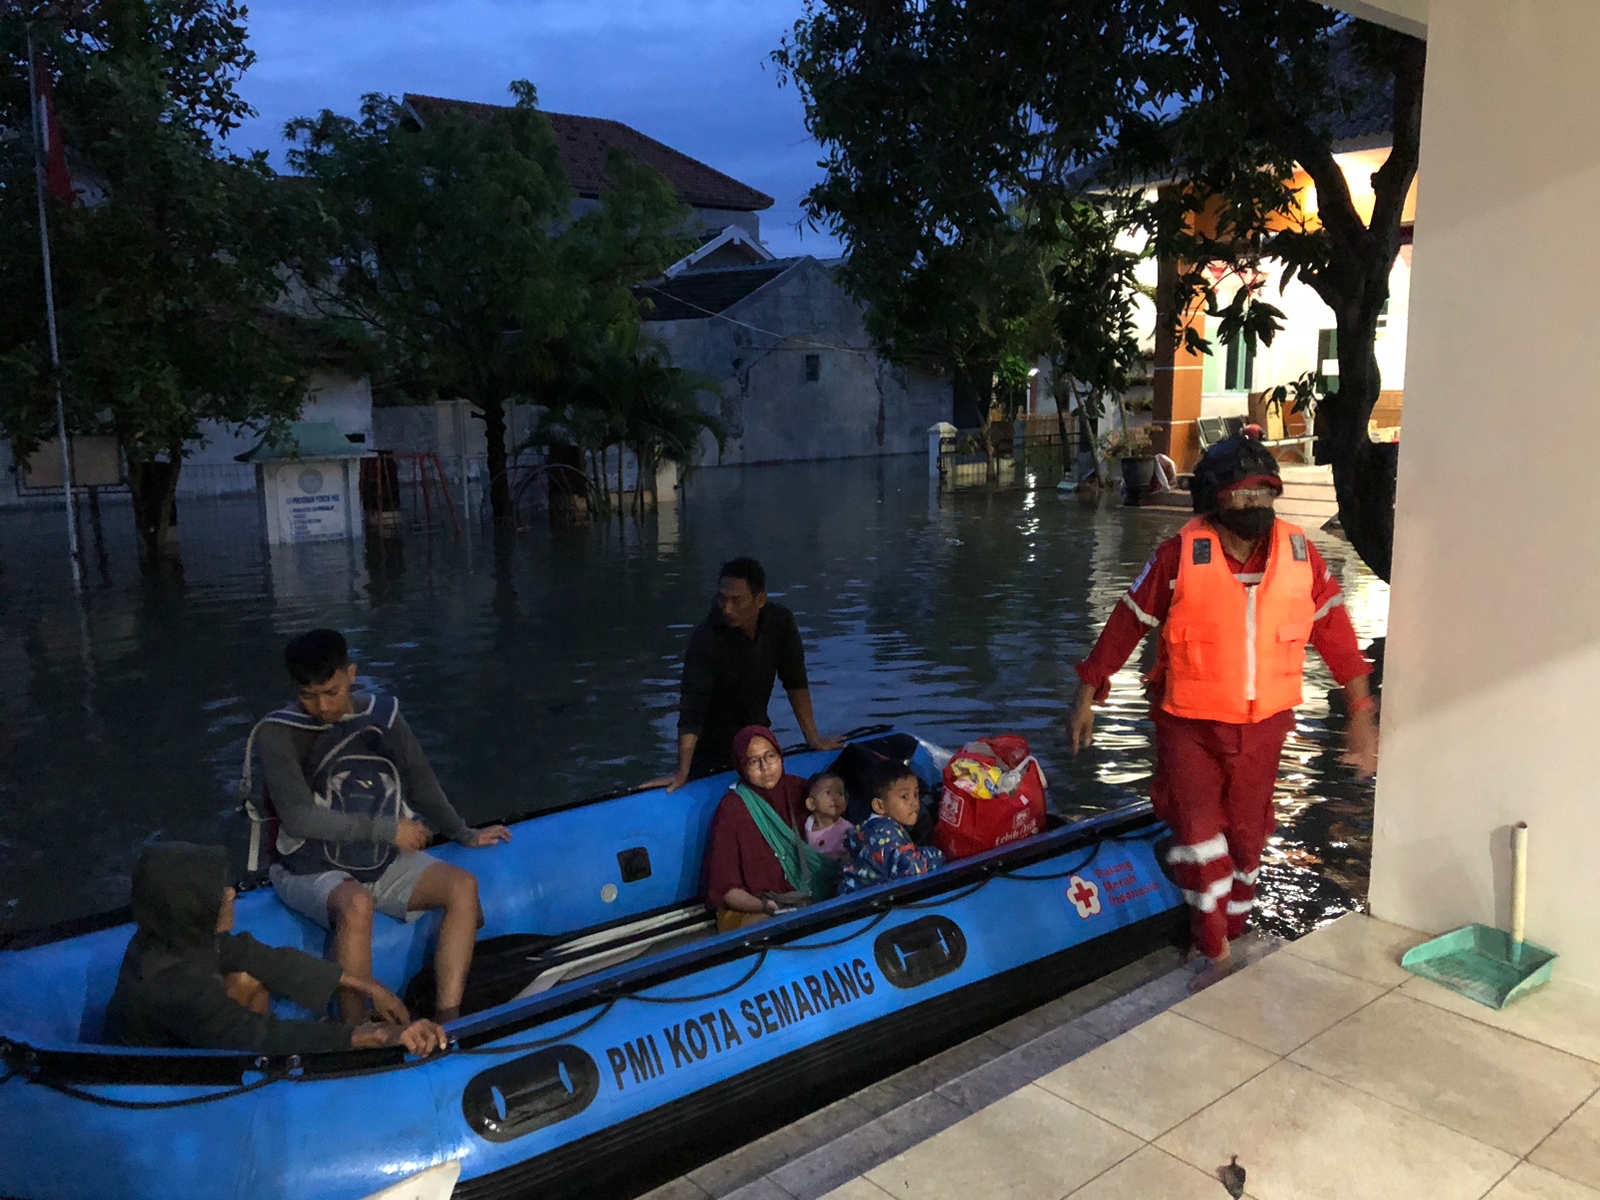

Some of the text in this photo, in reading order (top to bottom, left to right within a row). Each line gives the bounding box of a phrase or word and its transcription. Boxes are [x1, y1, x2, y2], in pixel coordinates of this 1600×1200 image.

[995, 829, 1019, 846] Lebih
[1095, 860, 1134, 879] Palang
[1102, 875, 1137, 893] Merah
[1108, 881, 1160, 906] Indonesia
[606, 958, 876, 1090] PMI KOTA SEMARANG
